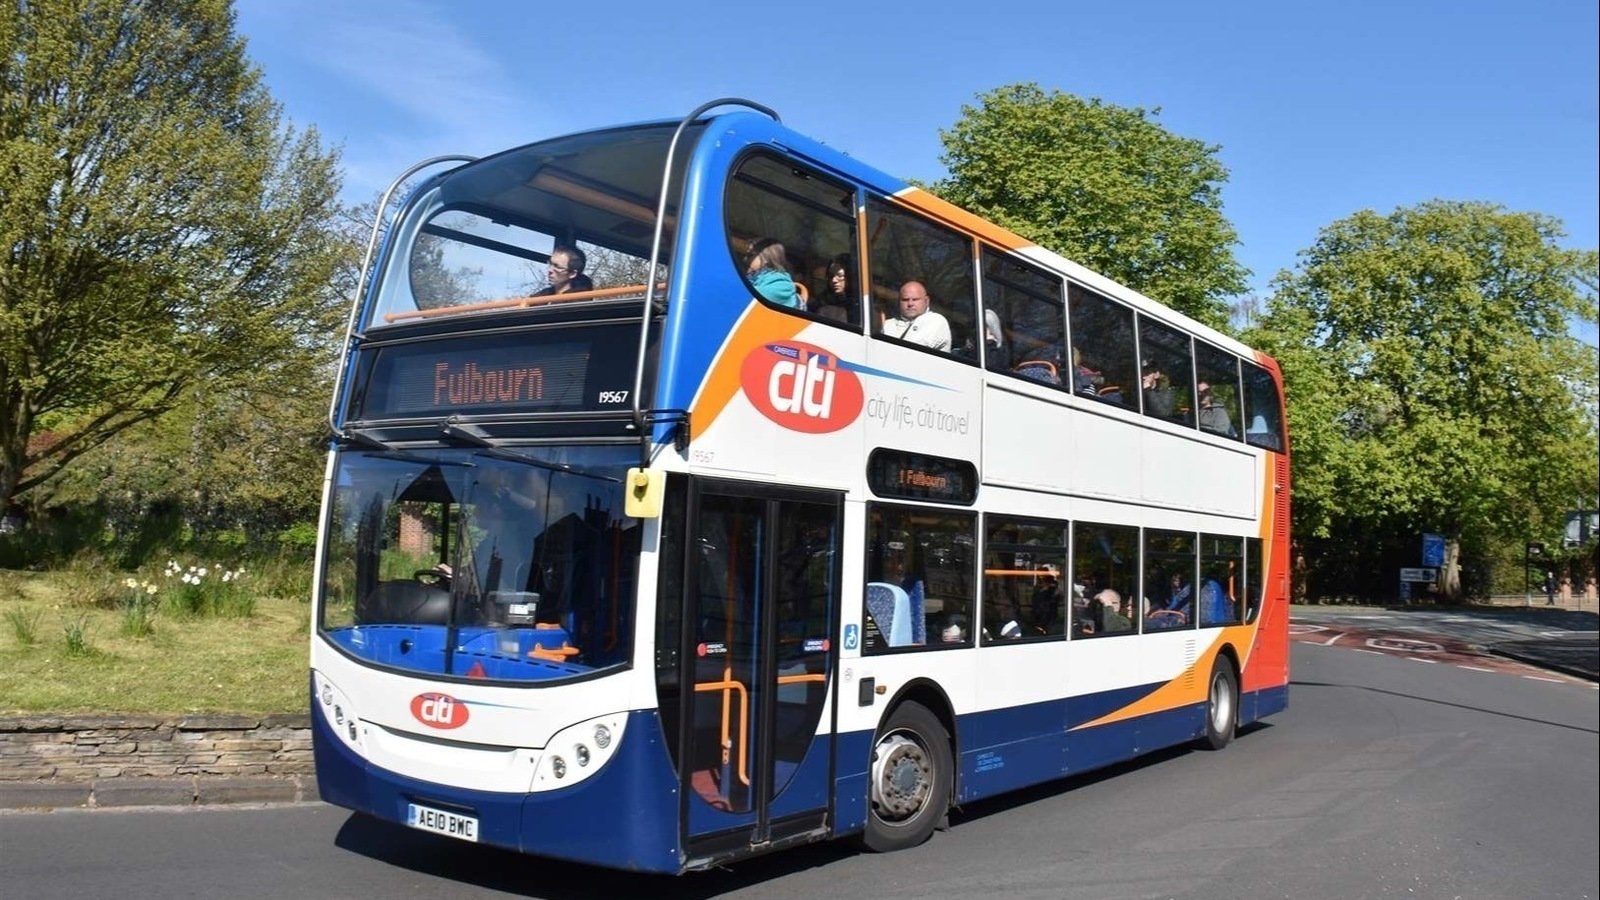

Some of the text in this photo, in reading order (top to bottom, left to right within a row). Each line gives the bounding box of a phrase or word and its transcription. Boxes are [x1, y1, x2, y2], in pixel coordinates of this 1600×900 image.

[434, 362, 544, 405] Fulbourn
[598, 390, 629, 403] 19567
[768, 350, 836, 419] citi
[867, 393, 970, 435] city life, citi travel
[420, 696, 455, 725] citi
[419, 810, 474, 837] AE10 BWC
